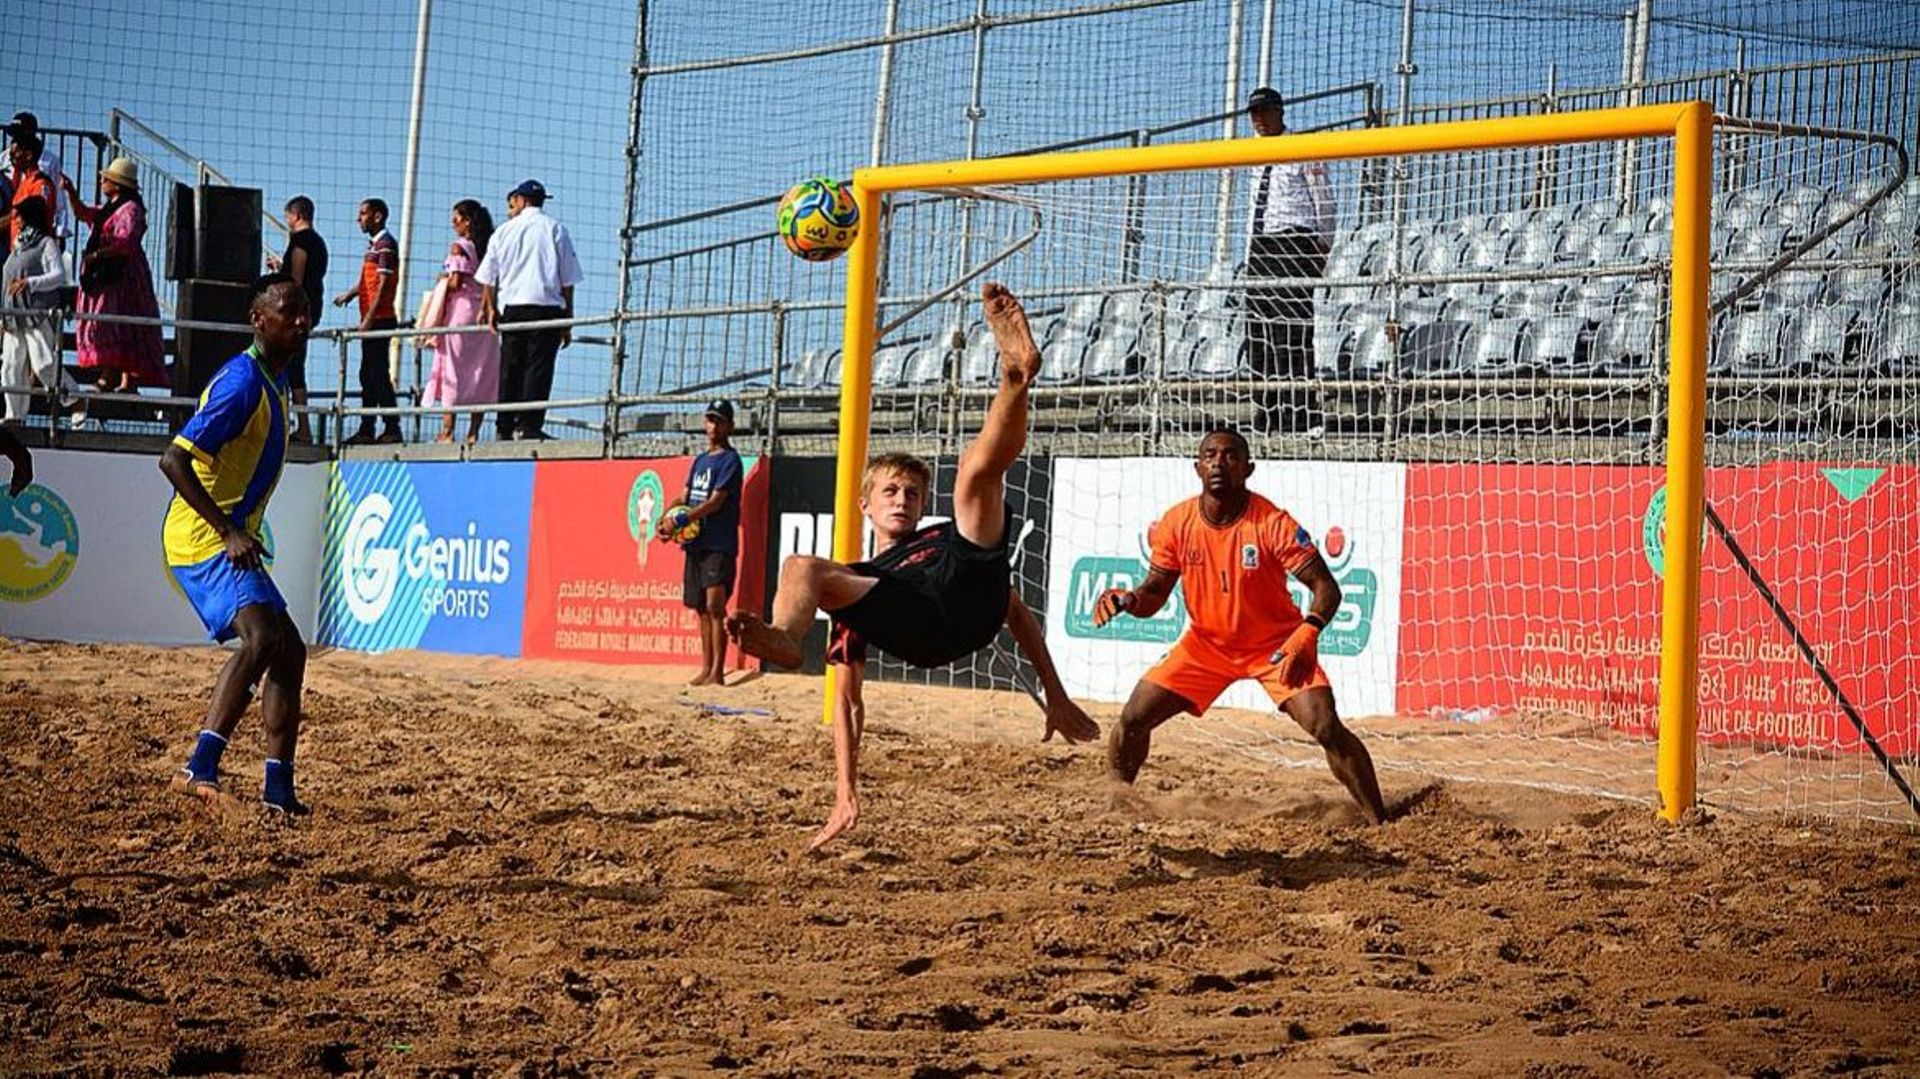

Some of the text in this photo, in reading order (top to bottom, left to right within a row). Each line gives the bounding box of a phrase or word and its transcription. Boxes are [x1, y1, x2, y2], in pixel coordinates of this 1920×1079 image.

[405, 522, 511, 584] Genius
[422, 587, 490, 619] SPORTS
[1734, 710, 1752, 735] DE
[1756, 712, 1830, 740] FOOTBALL
